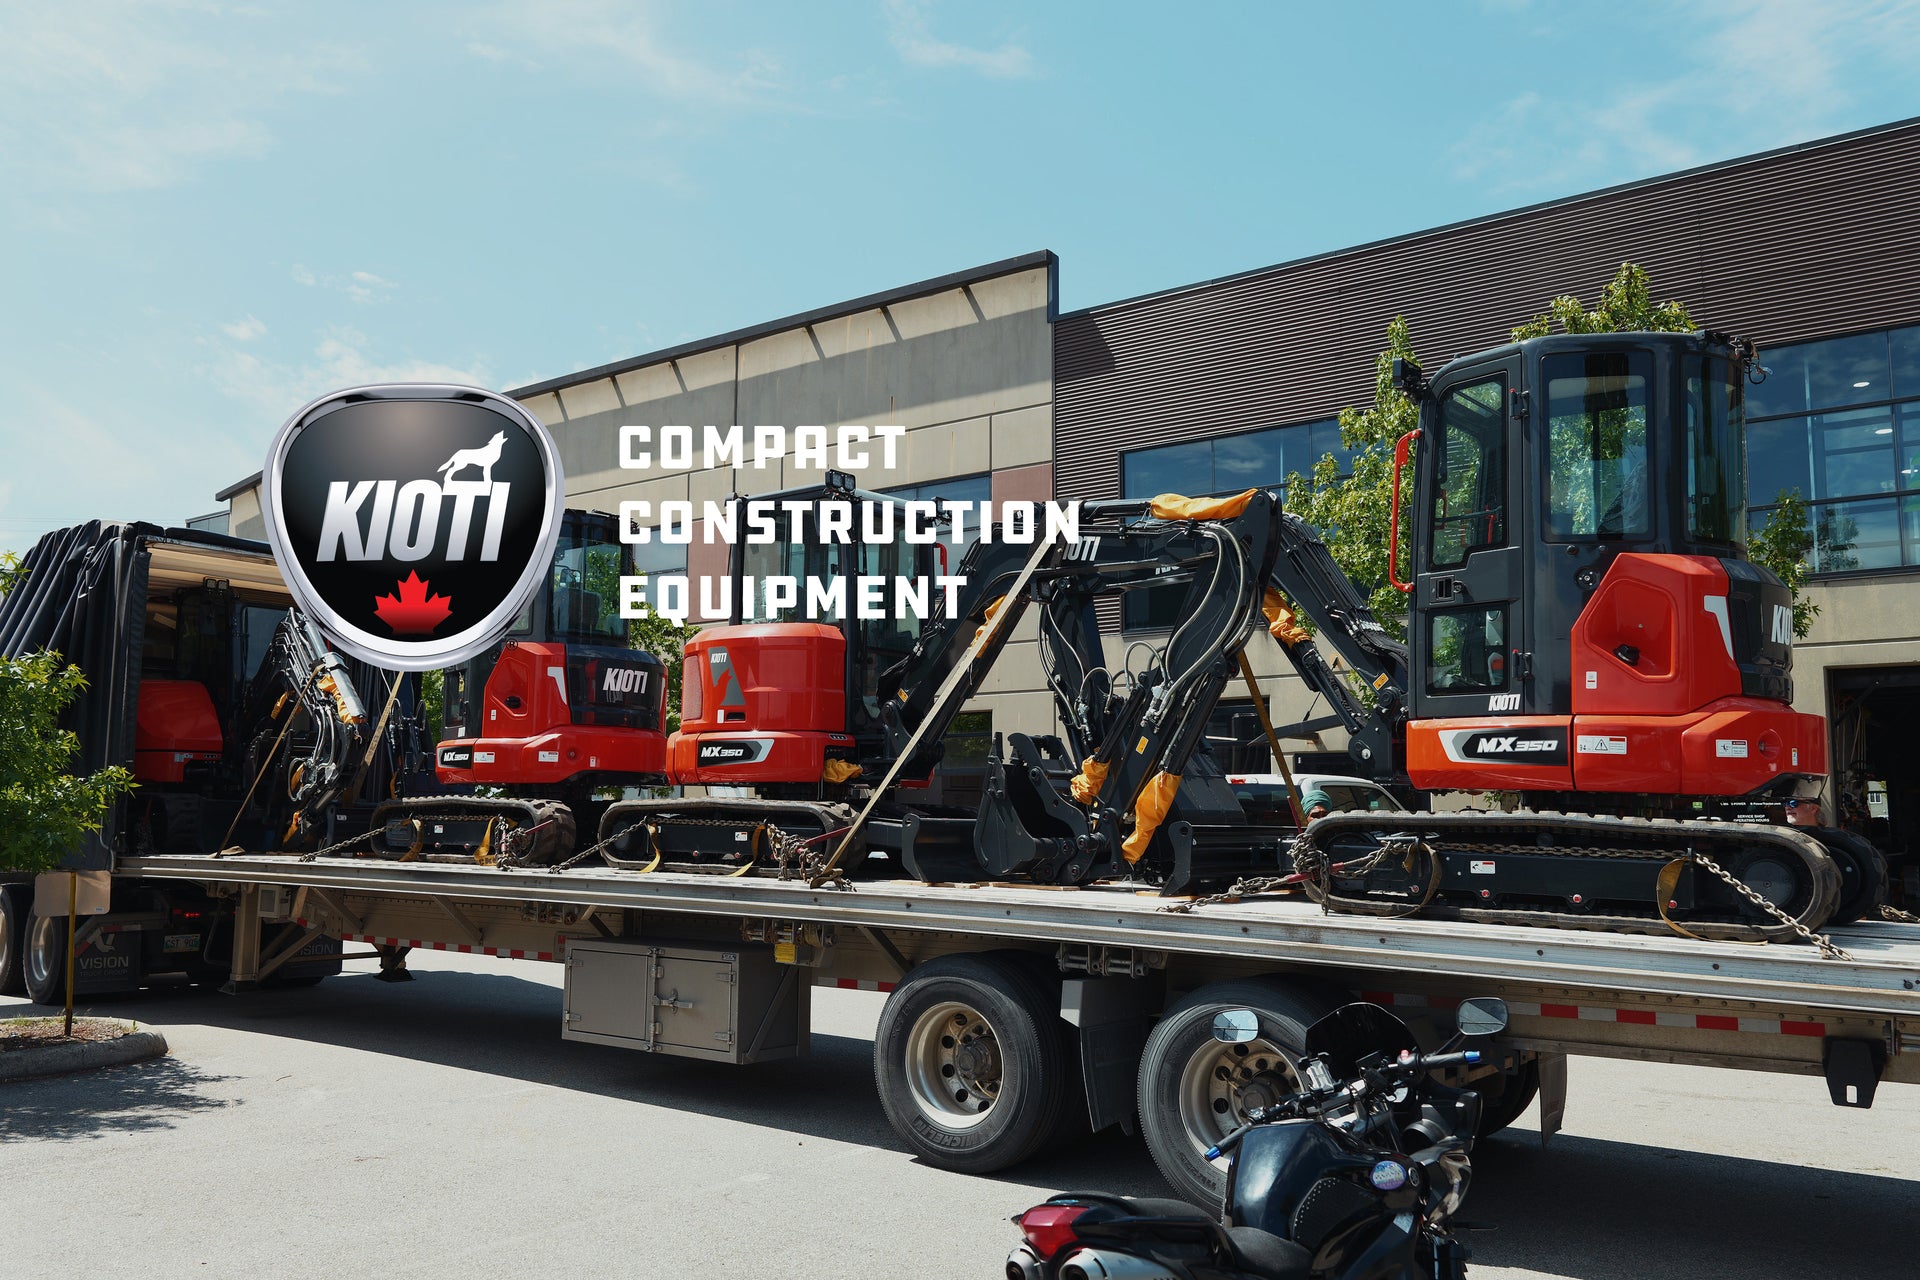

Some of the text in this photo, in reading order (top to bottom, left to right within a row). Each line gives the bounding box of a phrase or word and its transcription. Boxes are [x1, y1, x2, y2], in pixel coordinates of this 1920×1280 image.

[1062, 536, 1101, 561] IOTI
[1771, 604, 1793, 646] KIO
[710, 652, 728, 664] KIOTI
[602, 667, 649, 694] KIOTI
[1488, 693, 1521, 711] KIOTI
[700, 746, 744, 757] MX350
[1476, 736, 1559, 753] MX350
[296, 944, 334, 956] ISION
[79, 955, 129, 970] VISION
[912, 1116, 980, 1148] MICHELIN
